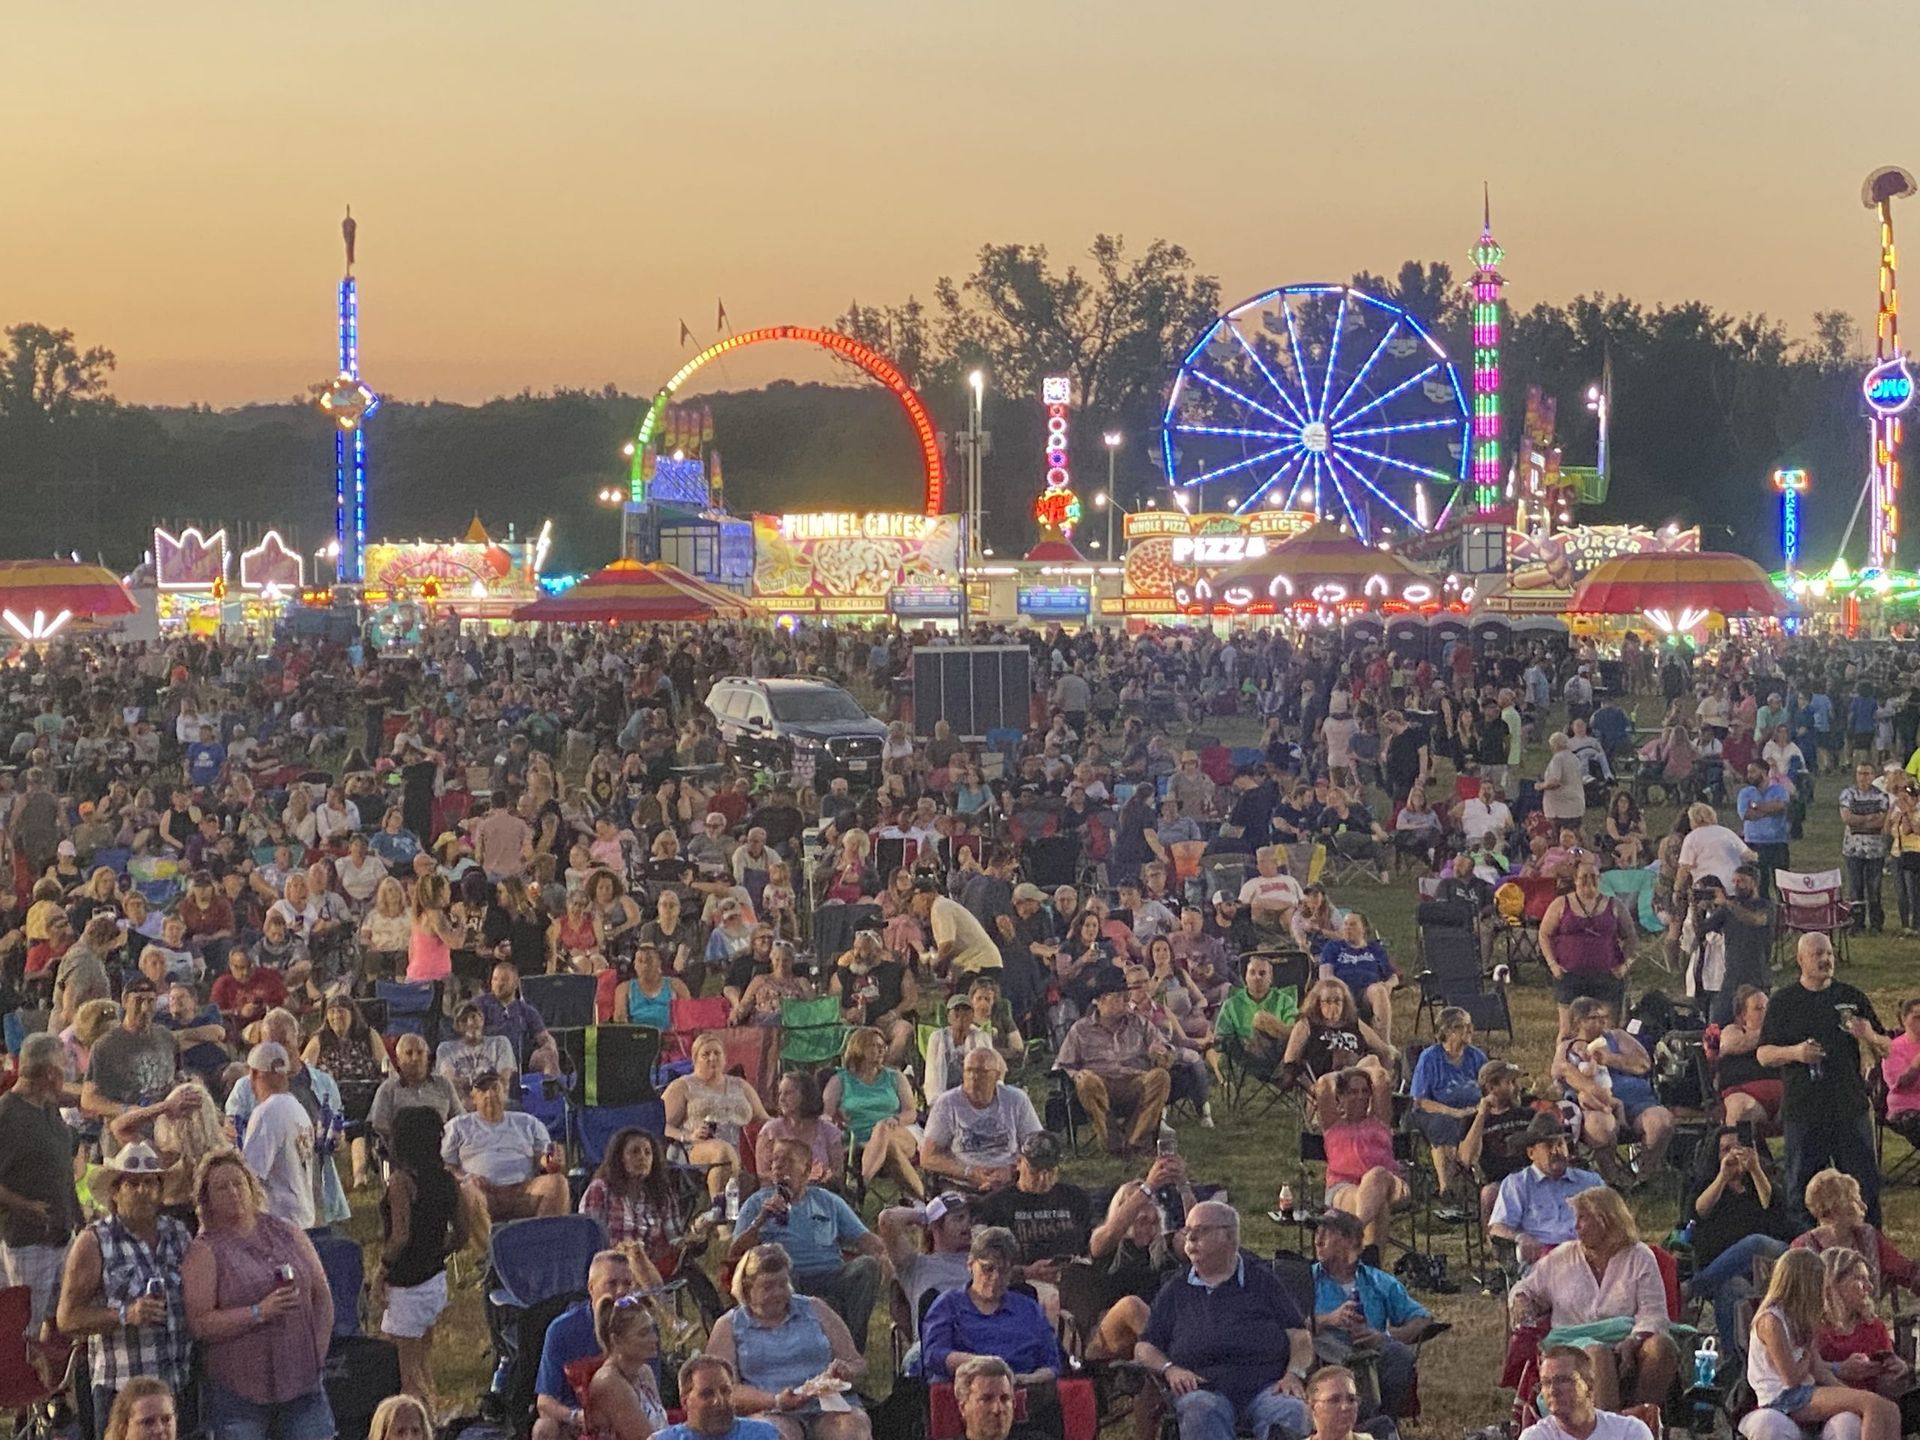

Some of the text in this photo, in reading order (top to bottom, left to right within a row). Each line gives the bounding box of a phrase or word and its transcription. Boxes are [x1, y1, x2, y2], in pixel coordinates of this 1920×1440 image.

[783, 511, 927, 538] FUNNEL CAKES
[1128, 519, 1191, 534] WHOLE PIZZA
[1250, 518, 1313, 534] SLICES
[1172, 536, 1267, 562] PIZZA
[1564, 534, 1642, 555] BURGER
[822, 599, 884, 609] ICE CREAM
